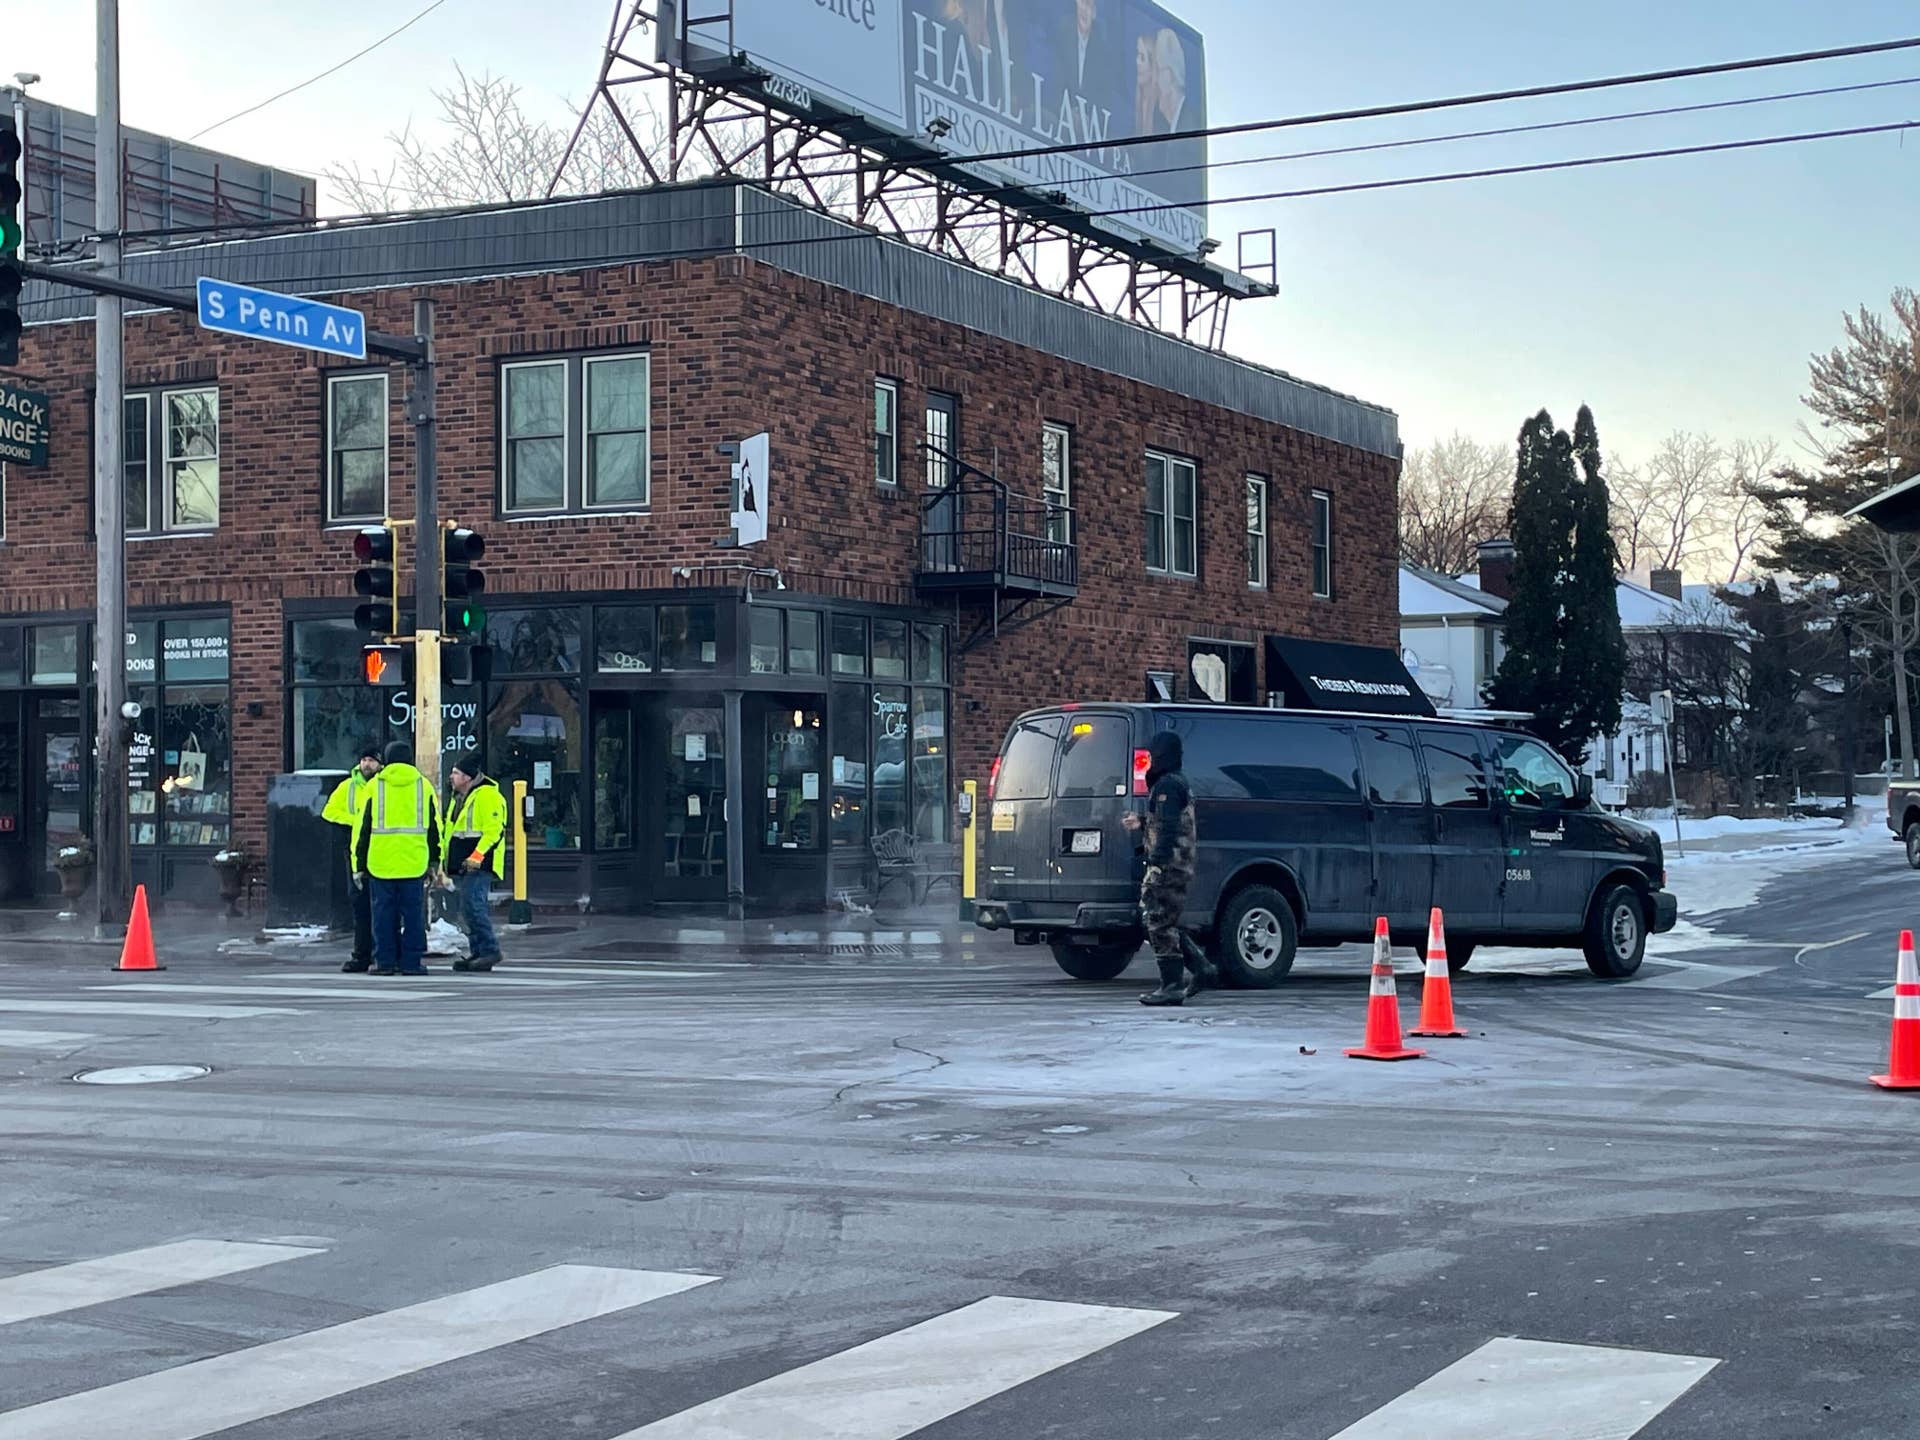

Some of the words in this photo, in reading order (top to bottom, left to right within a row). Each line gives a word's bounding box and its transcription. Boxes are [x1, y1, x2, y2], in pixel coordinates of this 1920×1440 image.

[815, 0, 876, 31] ce
[912, 12, 1023, 126] HALL
[1032, 72, 1112, 164] LAW
[1037, 150, 1102, 206] INJURY
[1110, 182, 1206, 247] ATTORNEYS
[207, 290, 226, 320] S
[239, 296, 309, 338] Penn
[322, 315, 356, 346] Av
[164, 638, 188, 649] OVER
[202, 648, 229, 658] STOCK
[126, 659, 155, 671] OOKS
[388, 691, 477, 733] Sprow
[872, 692, 908, 721] Sparrow
[440, 720, 479, 754] afe
